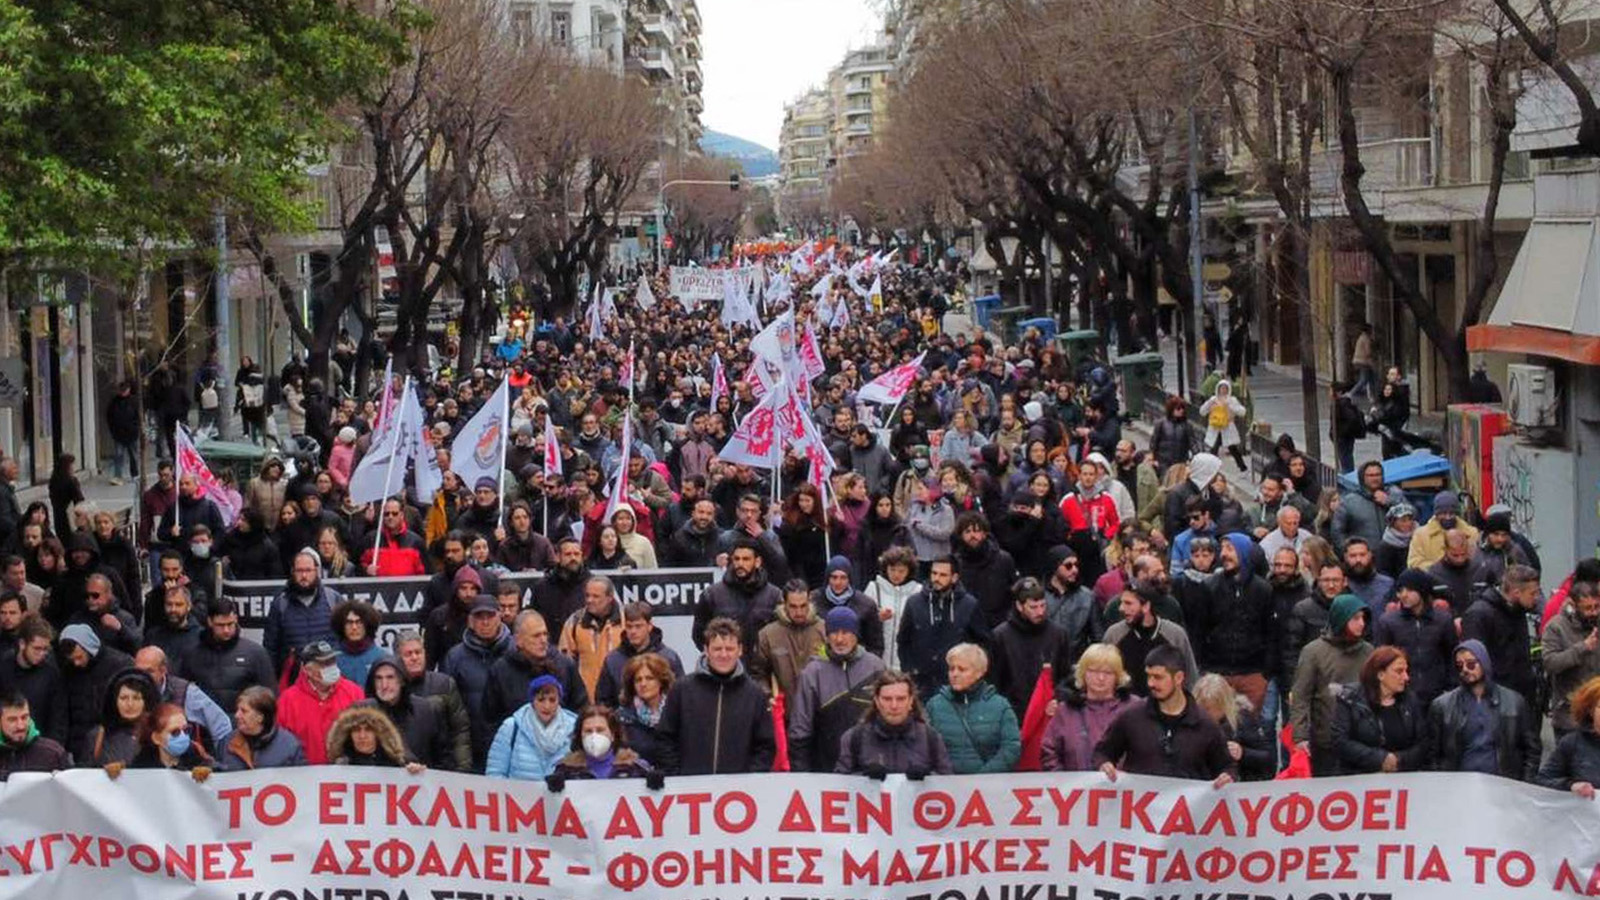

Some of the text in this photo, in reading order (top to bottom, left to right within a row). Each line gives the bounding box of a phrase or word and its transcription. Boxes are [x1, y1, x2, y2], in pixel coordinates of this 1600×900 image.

[219, 781, 1409, 841] ΤΟ ΕΓΚΛΗΜΑ ΑΥΤΟ ΔΕΝ ΘΑ ΣΥΓΚΑΛΥΦΘΕΙ
[312, 839, 550, 887] ΑΣΦΑΛΕΙΣ
[605, 846, 825, 893] ΦΘΗΝΕΣ
[842, 837, 1051, 887] ΜΑΖΙΚΕΣ
[1068, 840, 1359, 886] ΜΕΤΑΦΟΡΕΣ
[1376, 843, 1450, 882] ΓΙΑ
[1464, 847, 1537, 888] ΤΟ
